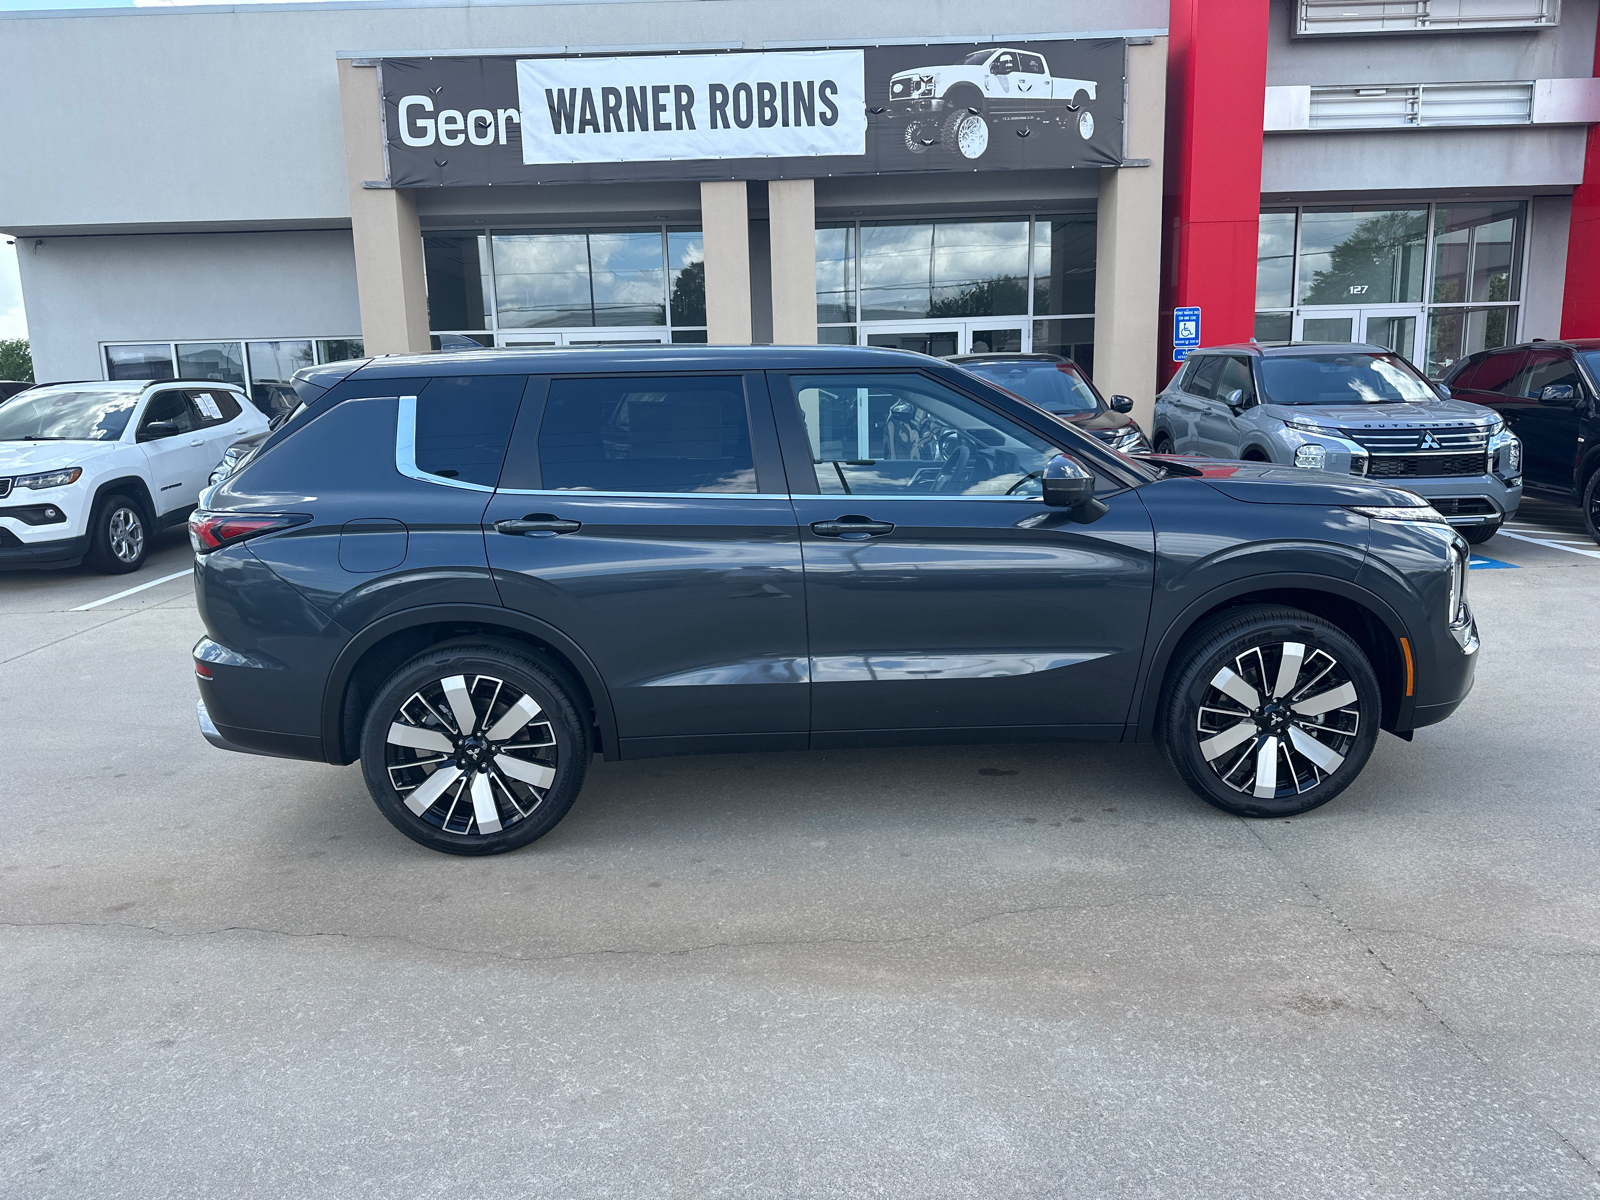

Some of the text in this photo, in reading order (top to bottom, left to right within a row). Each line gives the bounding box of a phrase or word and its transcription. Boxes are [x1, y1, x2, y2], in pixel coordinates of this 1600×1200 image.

[398, 94, 520, 147] Geor
[545, 79, 839, 134] WARNER ROBINS
[1349, 285, 1369, 295] 127
[1300, 770, 1351, 808] NEXEN
